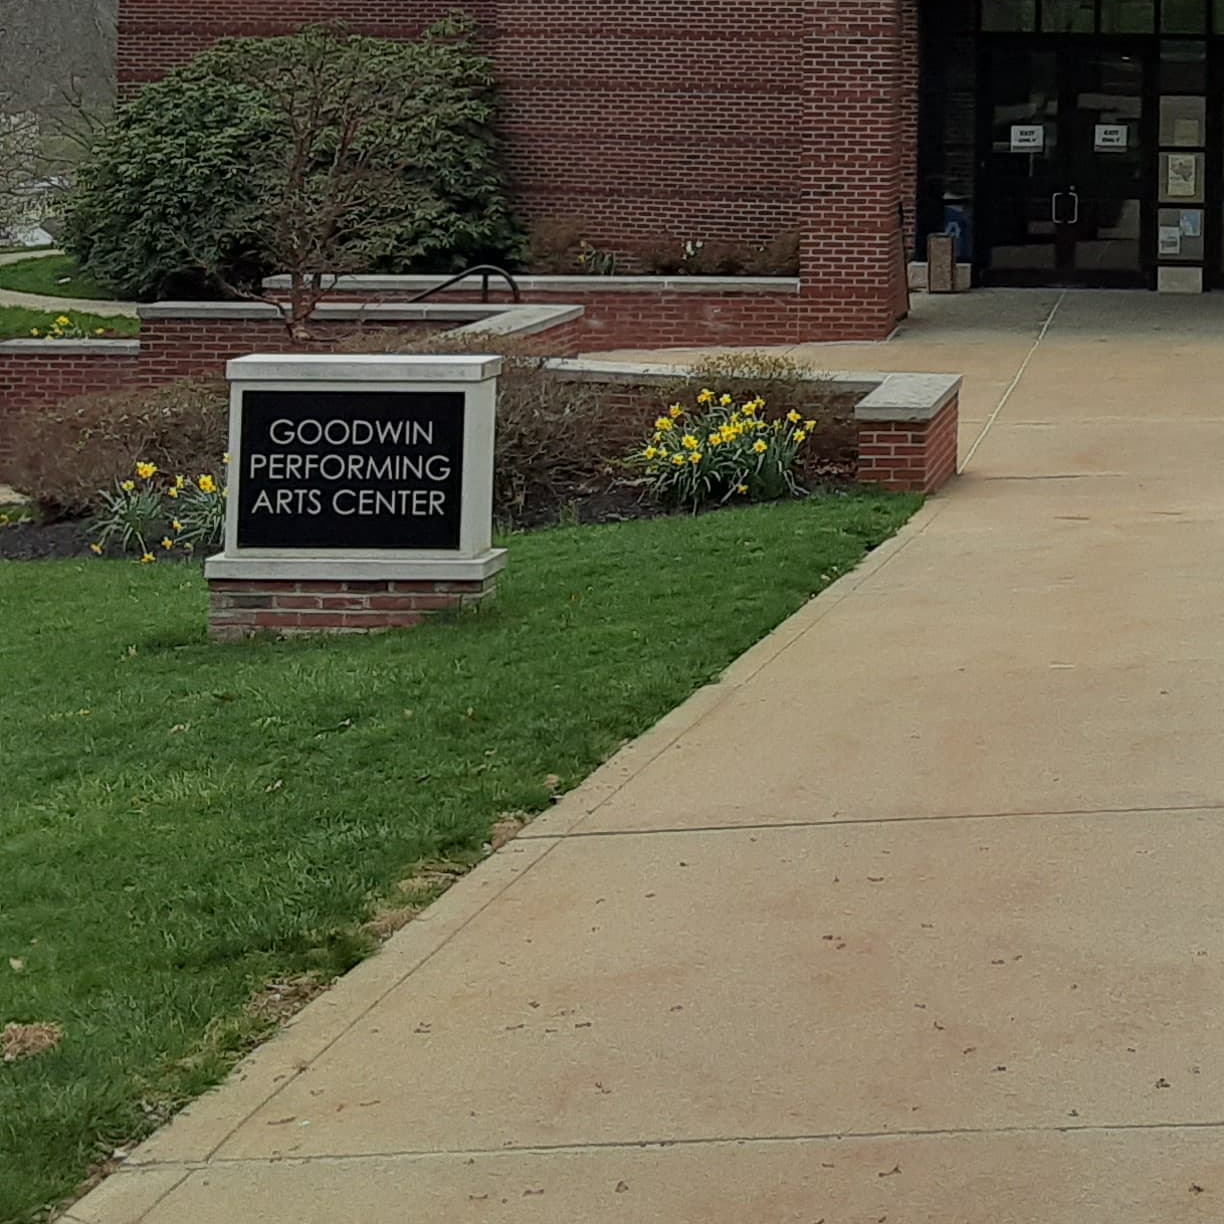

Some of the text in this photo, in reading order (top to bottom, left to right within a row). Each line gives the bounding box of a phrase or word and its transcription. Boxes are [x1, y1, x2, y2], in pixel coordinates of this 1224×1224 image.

[269, 419, 433, 445] GOODWIN
[250, 454, 451, 481] PERFORMING
[251, 489, 445, 516] ARTS CENTER
